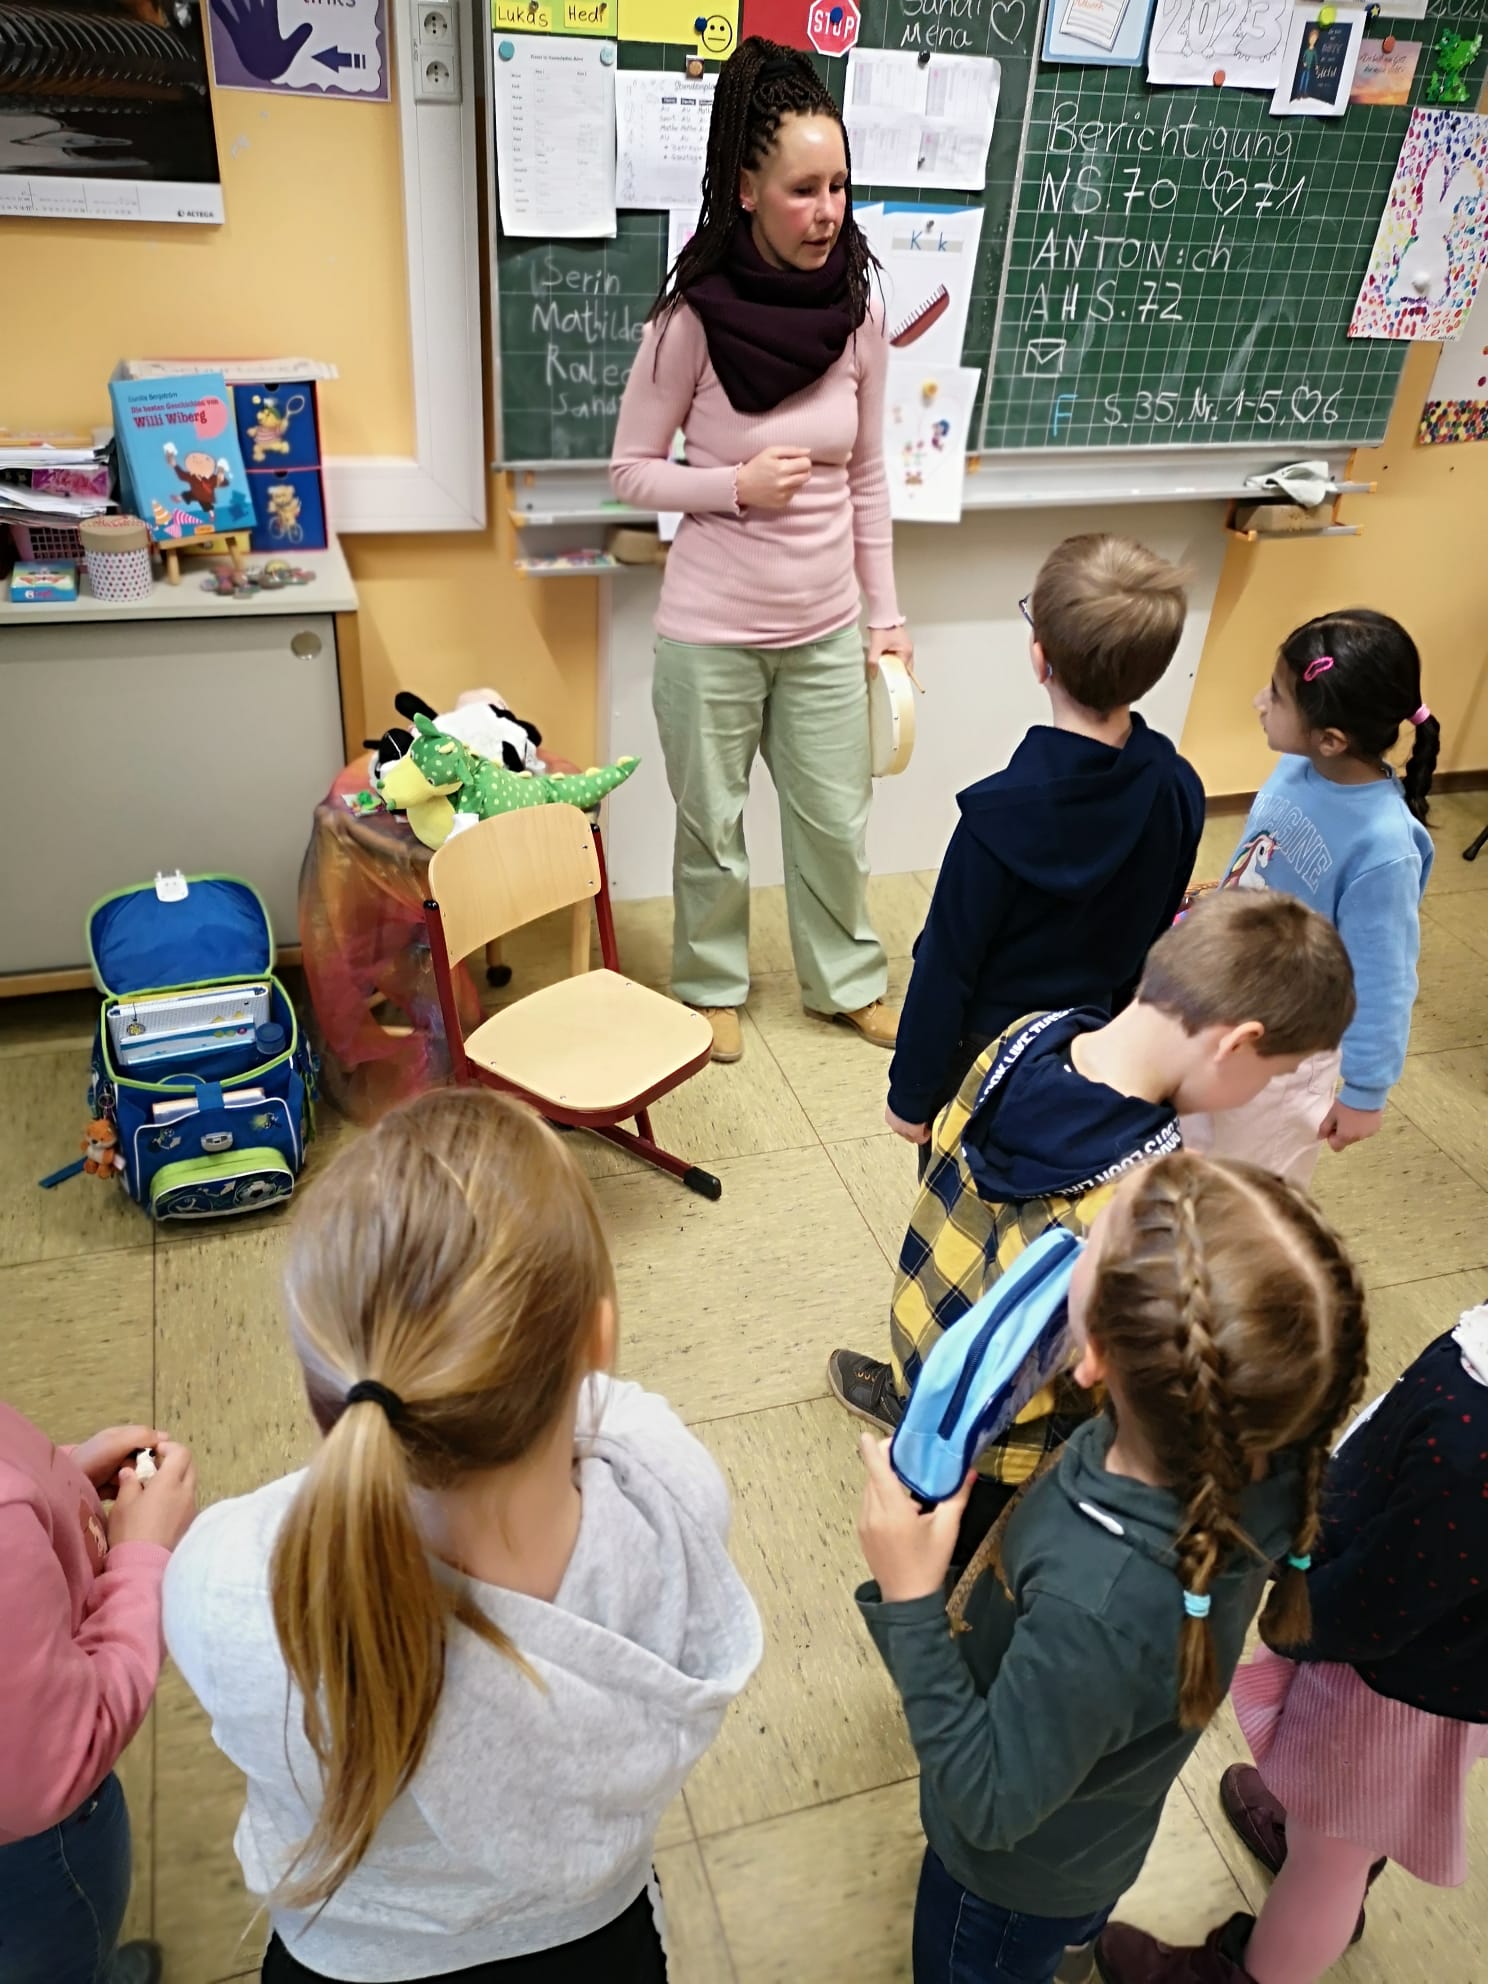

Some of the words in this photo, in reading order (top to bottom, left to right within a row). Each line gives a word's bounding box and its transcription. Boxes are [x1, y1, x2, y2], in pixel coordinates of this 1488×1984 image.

[498, 6, 549, 27] Lukas
[1050, 101, 1293, 190] Berichtigung
[133, 414, 164, 429] Willi
[165, 410, 208, 424] Wiberg
